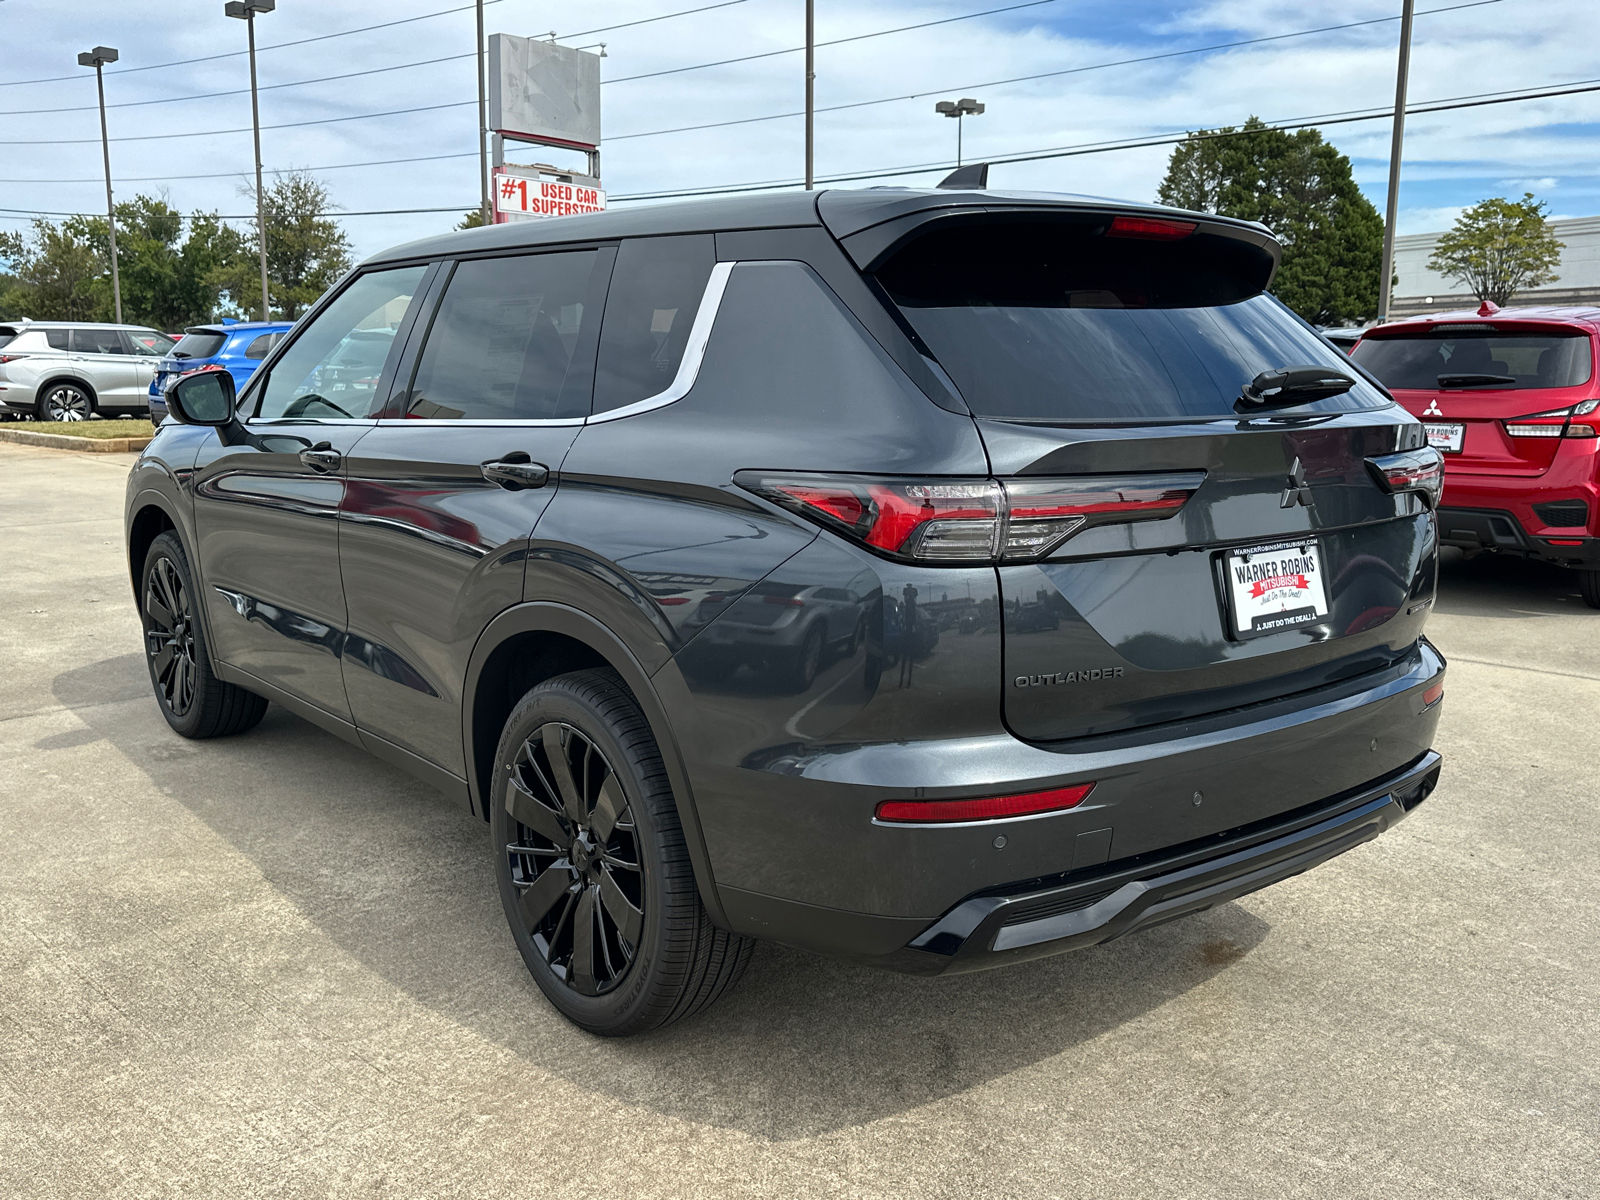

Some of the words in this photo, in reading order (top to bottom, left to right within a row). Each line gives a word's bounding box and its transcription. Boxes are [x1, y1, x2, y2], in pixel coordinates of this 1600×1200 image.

[501, 178, 527, 211] #1
[541, 182, 572, 201] USED
[576, 187, 598, 205] CAR
[532, 197, 605, 216] SUPERSTO
[1235, 561, 1278, 584] WARNER
[1281, 555, 1315, 576] ROBINS
[1259, 575, 1299, 591] MITSUBISHI
[1260, 594, 1271, 605] Just
[1271, 591, 1278, 600] Do
[1279, 589, 1288, 599] The
[1262, 620, 1276, 630] JUST
[1275, 618, 1285, 627] DO
[1284, 617, 1296, 625] THE
[1295, 613, 1312, 623] DEAL!
[1014, 666, 1124, 688] OUTLANDER
